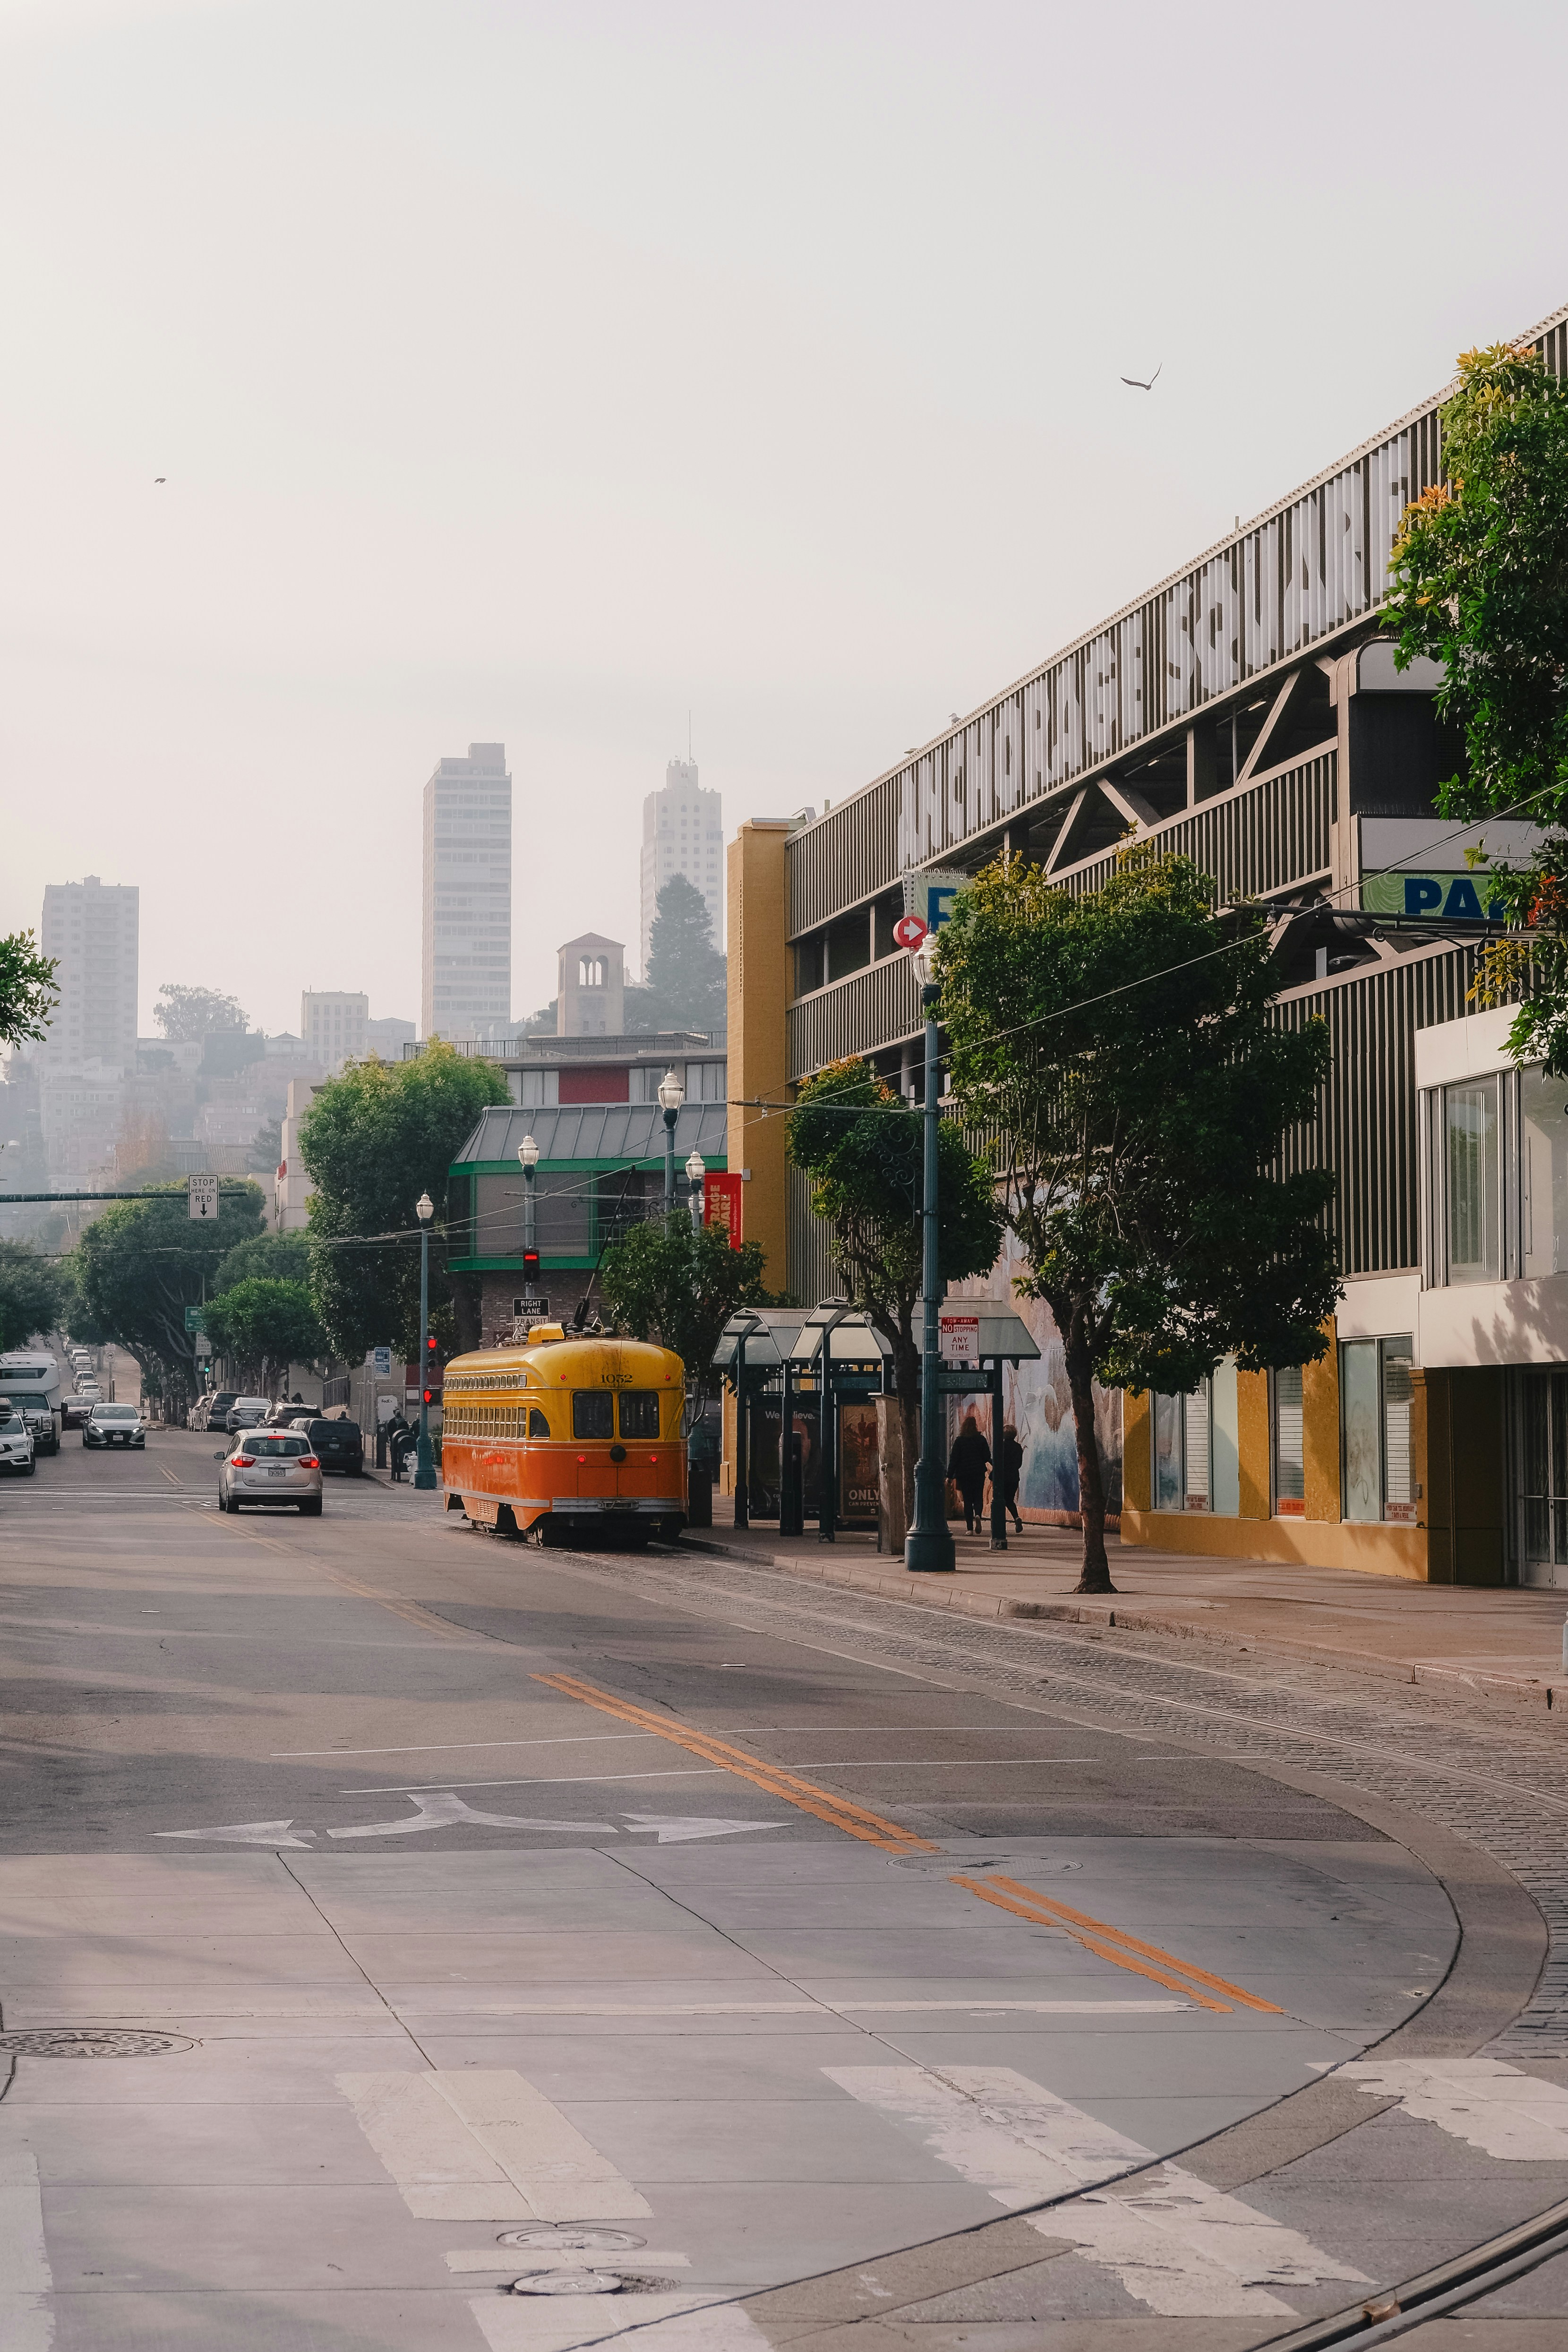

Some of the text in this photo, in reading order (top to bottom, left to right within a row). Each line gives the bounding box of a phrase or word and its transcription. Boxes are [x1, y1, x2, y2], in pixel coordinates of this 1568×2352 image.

[897, 436, 1409, 870] ANCHORAGE SQUARE
[710, 1185, 720, 1224] RAGE
[943, 1324, 953, 1332] NO
[600, 1374, 633, 1383] 1052
[792, 1411, 815, 1419] lieve.
